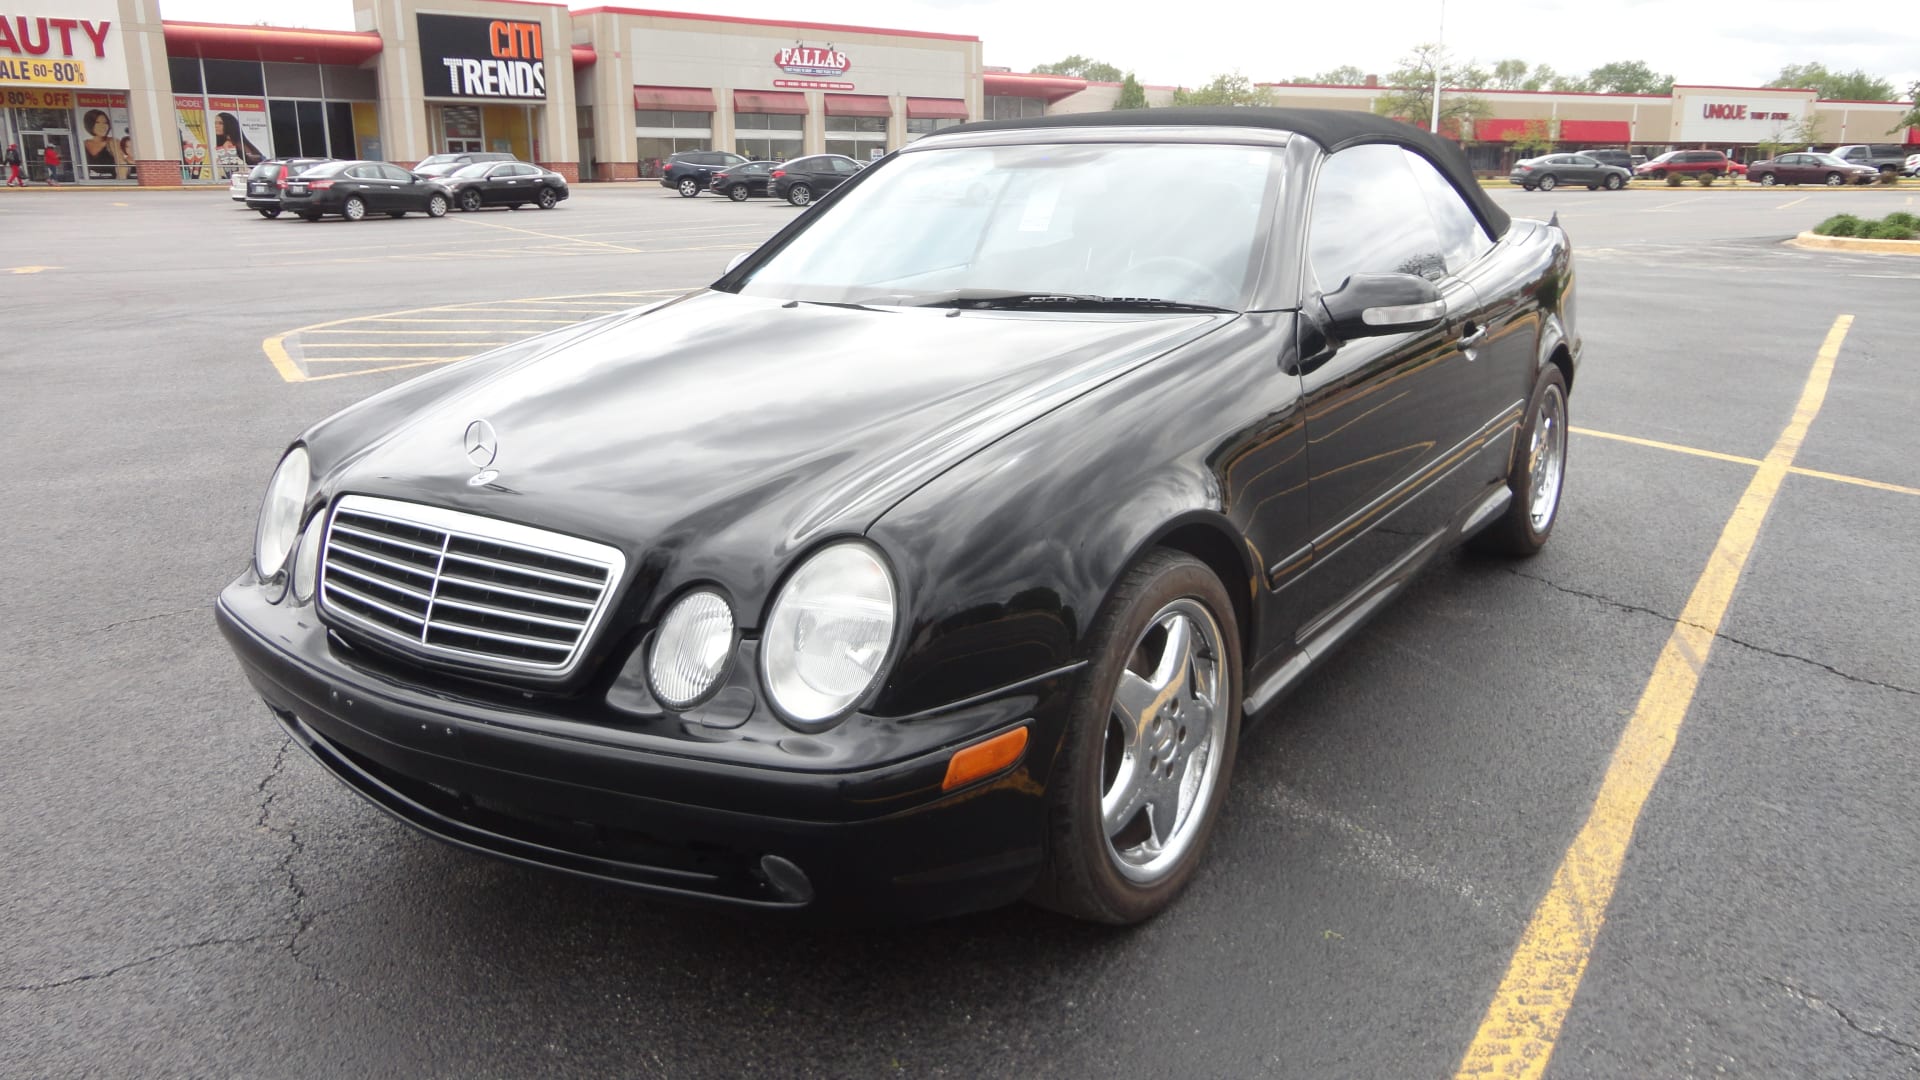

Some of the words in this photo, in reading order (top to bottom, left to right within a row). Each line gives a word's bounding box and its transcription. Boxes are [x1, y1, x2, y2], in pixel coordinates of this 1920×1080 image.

[0, 15, 111, 58] AUTY
[489, 20, 543, 59] CITI
[780, 47, 846, 69] FALLAS
[33, 62, 84, 82] 60-80%
[443, 58, 545, 97] TRENDS
[8, 91, 39, 106] 80%
[43, 92, 70, 107] OFF
[1703, 104, 1747, 119] UNIQUE
